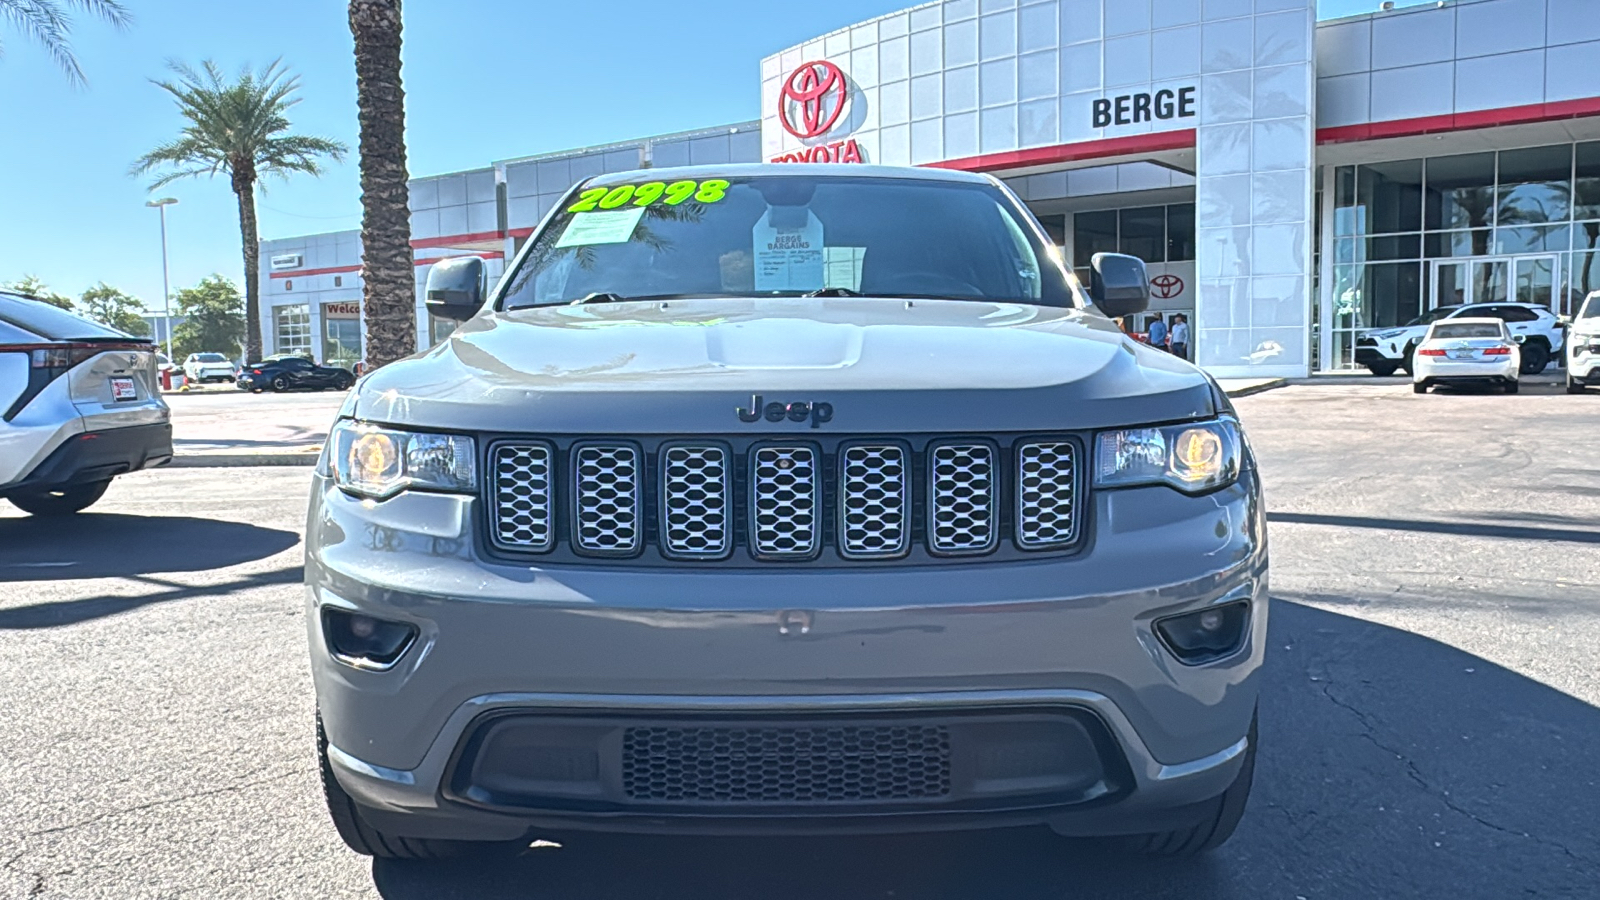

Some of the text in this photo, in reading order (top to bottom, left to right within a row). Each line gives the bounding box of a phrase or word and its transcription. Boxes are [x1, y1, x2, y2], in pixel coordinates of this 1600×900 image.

[1092, 86, 1196, 129] BERGE
[770, 138, 863, 163] YOTA
[567, 179, 731, 213] 20998
[767, 241, 810, 250] BARGAINS
[775, 234, 802, 243] BERGE
[736, 394, 834, 429] Jeep
